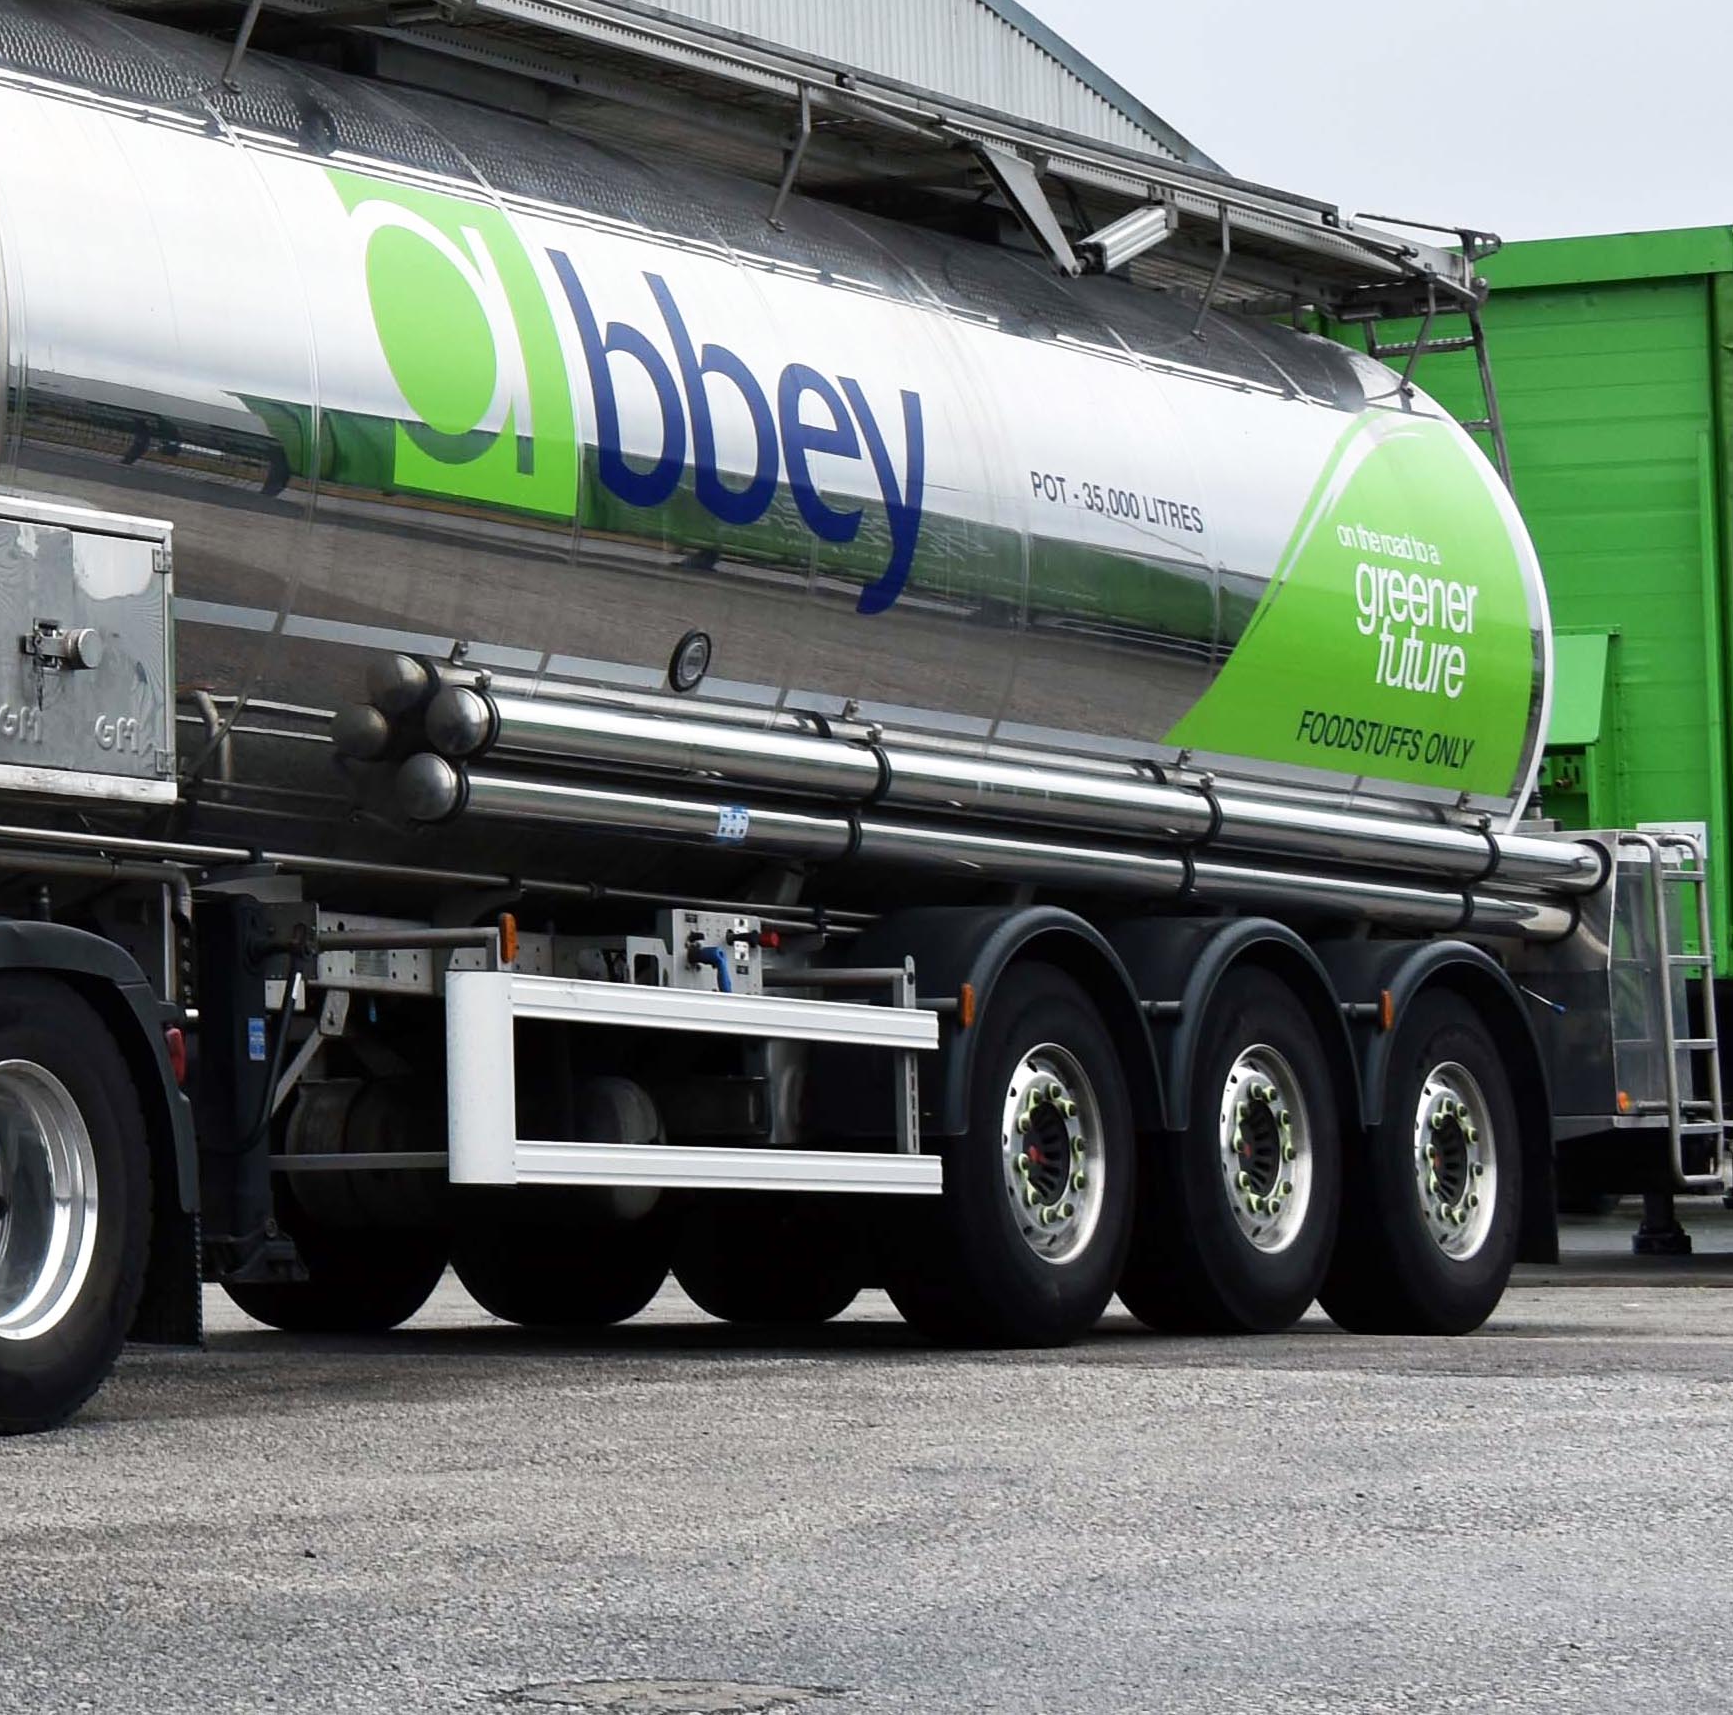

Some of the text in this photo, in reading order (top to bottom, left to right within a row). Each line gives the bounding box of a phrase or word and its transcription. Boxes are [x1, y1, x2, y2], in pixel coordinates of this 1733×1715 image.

[350, 198, 925, 615] abbey
[1031, 471, 1067, 503] POT
[1143, 496, 1204, 533] LITRES
[1337, 523, 1441, 565] on the road to a
[1356, 563, 1478, 635] greener
[1375, 617, 1466, 698] future
[1297, 710, 1475, 769] FOODSTUFFS ONLY
